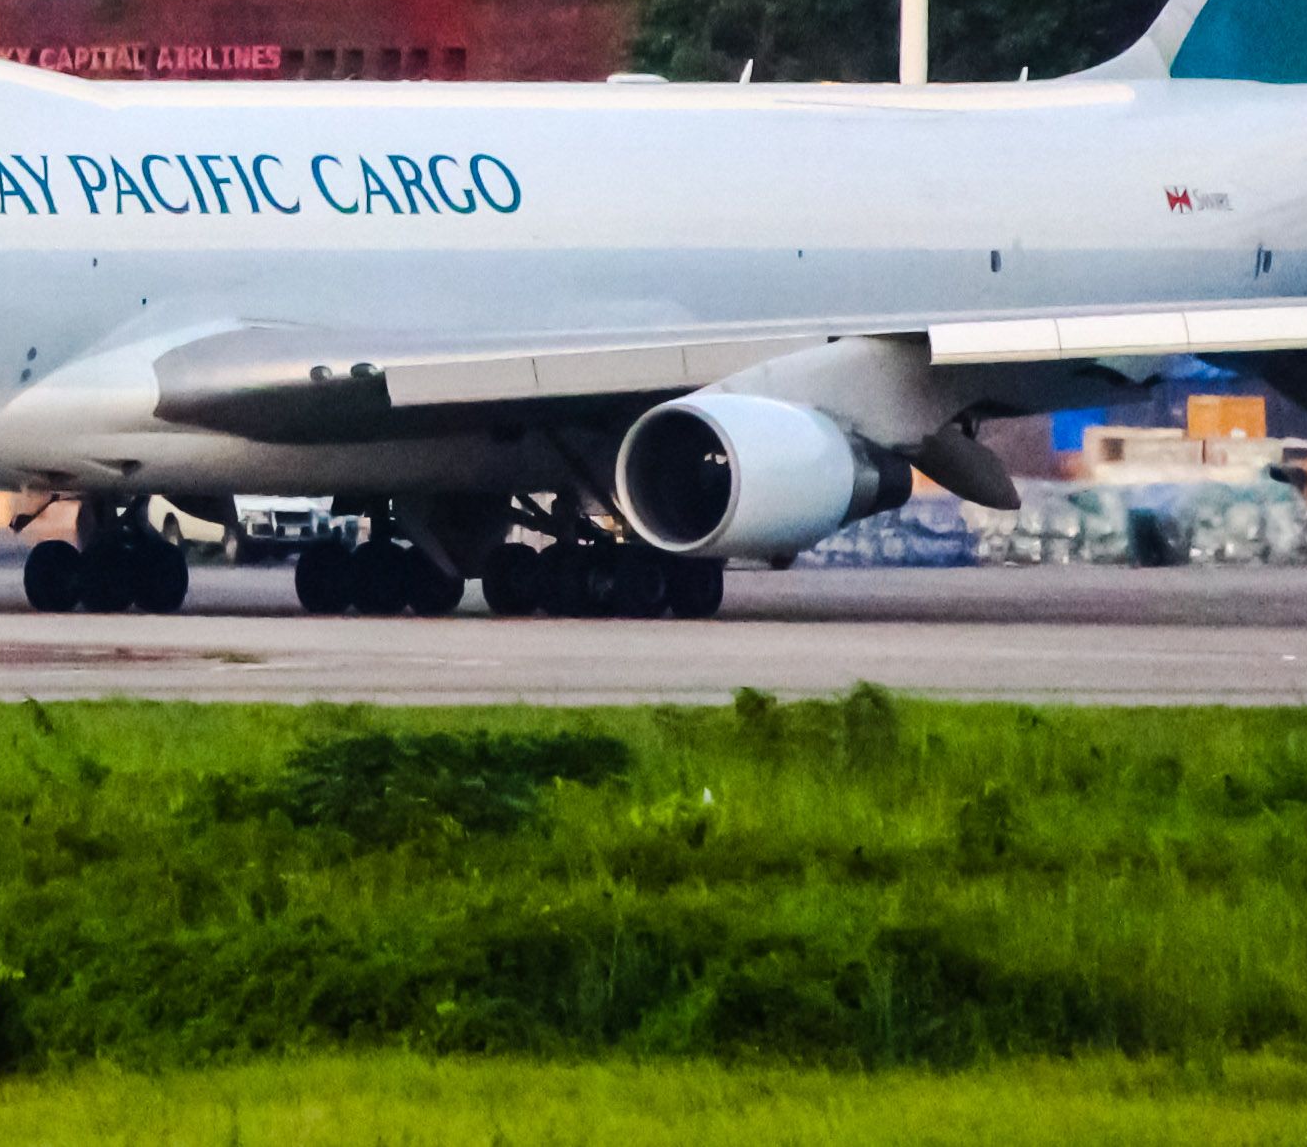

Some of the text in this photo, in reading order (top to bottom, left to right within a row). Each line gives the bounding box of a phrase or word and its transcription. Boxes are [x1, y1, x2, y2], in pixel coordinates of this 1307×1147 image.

[39, 45, 146, 71] CAPITAL
[156, 46, 281, 70] AIRLINES
[66, 153, 300, 215] PACIFIC
[310, 153, 522, 215] CARGO
